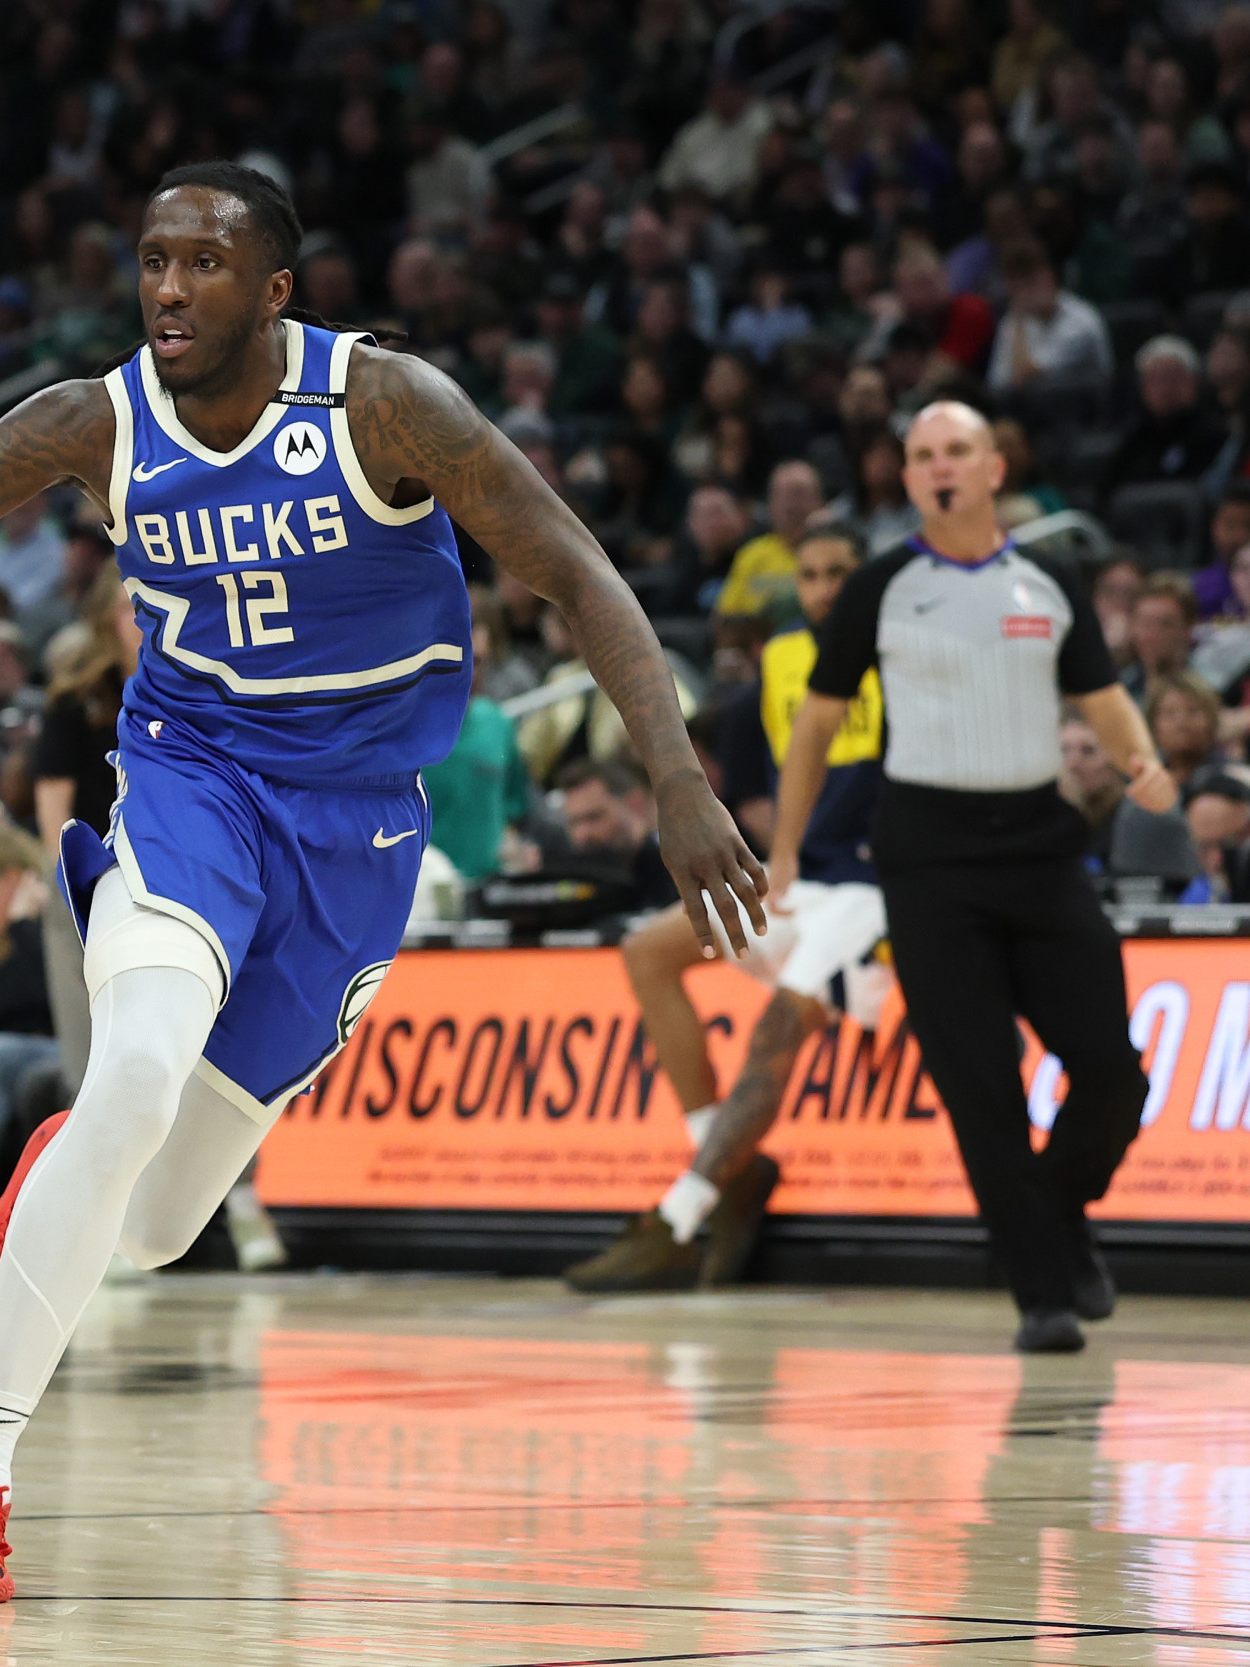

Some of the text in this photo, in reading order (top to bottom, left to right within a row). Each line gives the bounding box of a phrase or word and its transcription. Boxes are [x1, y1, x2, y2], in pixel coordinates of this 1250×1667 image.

[281, 393, 335, 406] BRIDGEMAN
[134, 494, 349, 566] BUCKS
[216, 571, 294, 648] 12
[286, 1016, 733, 1120] ISCONSIN
